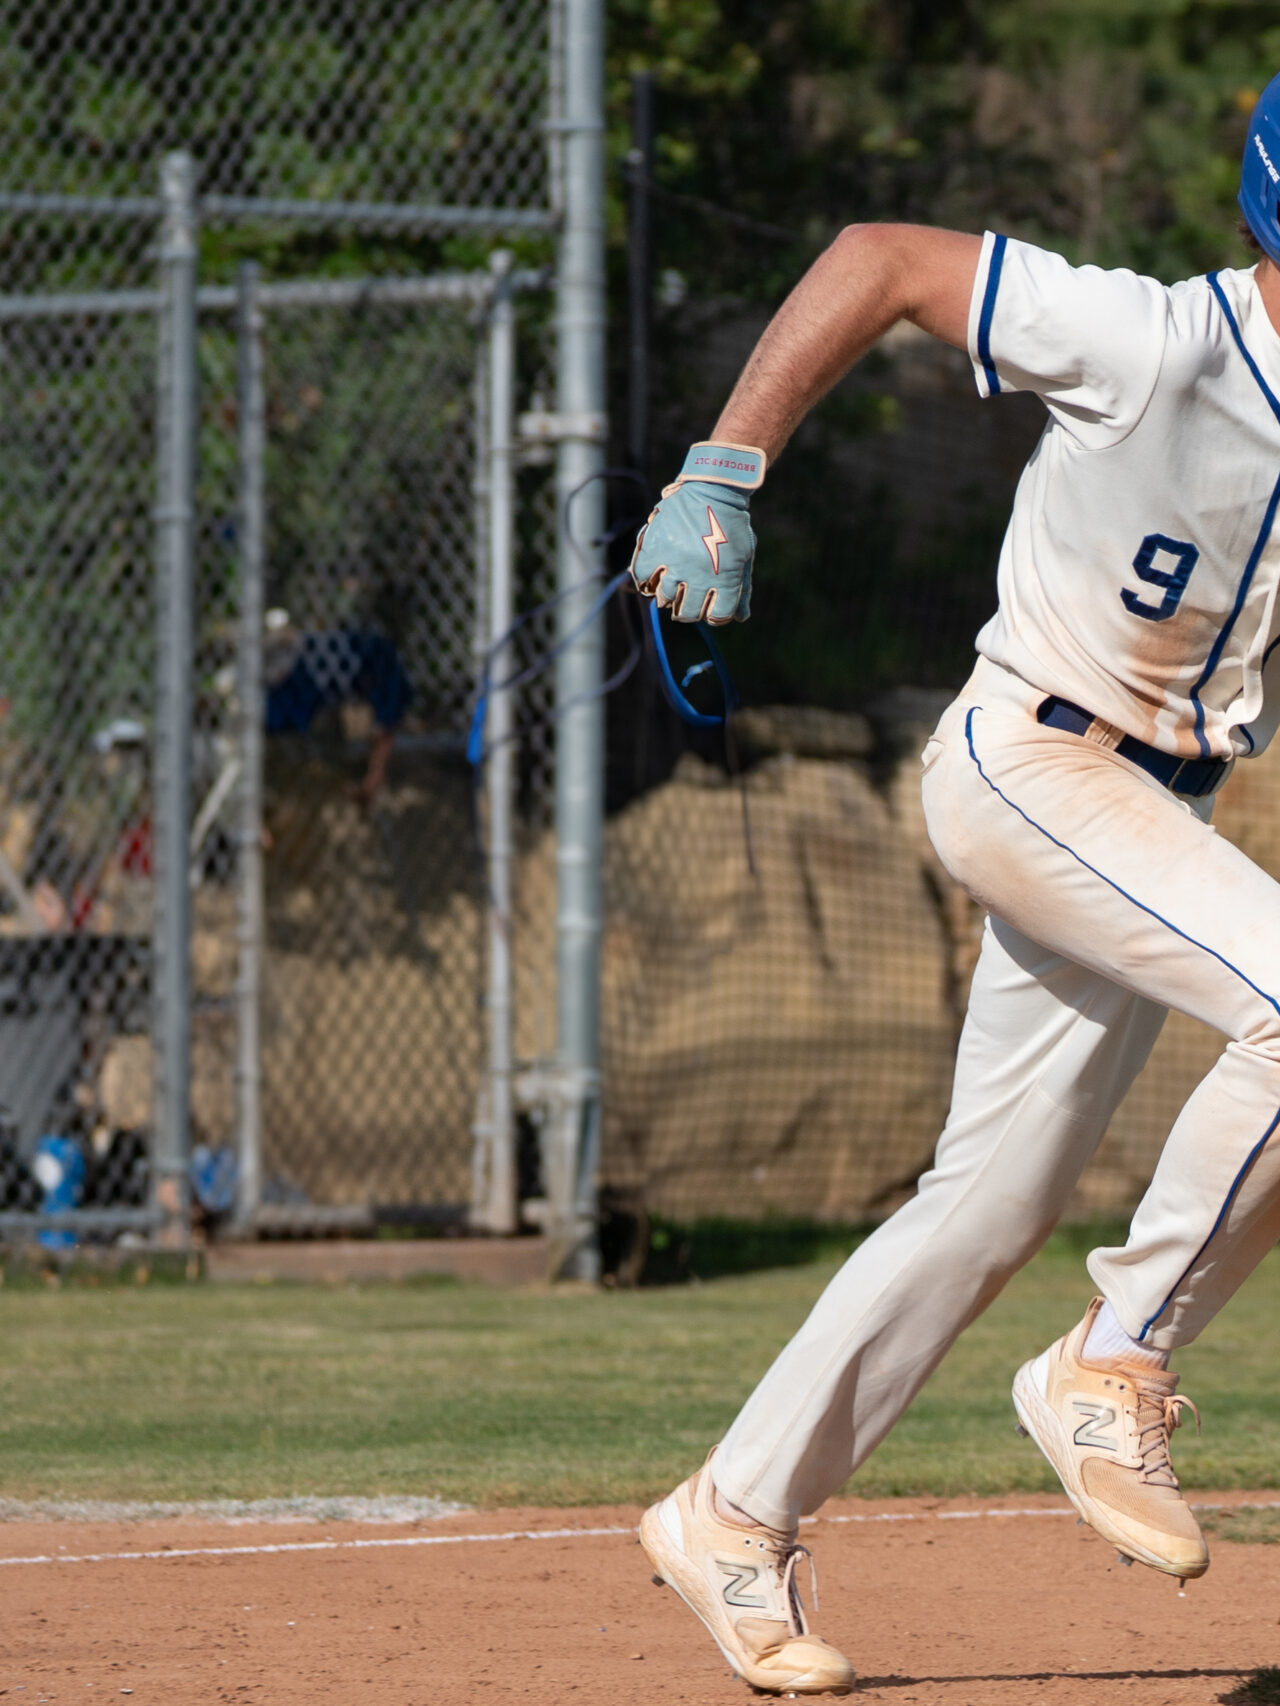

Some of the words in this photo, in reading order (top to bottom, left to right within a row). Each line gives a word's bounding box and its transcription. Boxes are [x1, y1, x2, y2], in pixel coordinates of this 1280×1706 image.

[1120, 533, 1199, 621] 9
[1072, 1402, 1119, 1451] N
[715, 1559, 767, 1608] N
